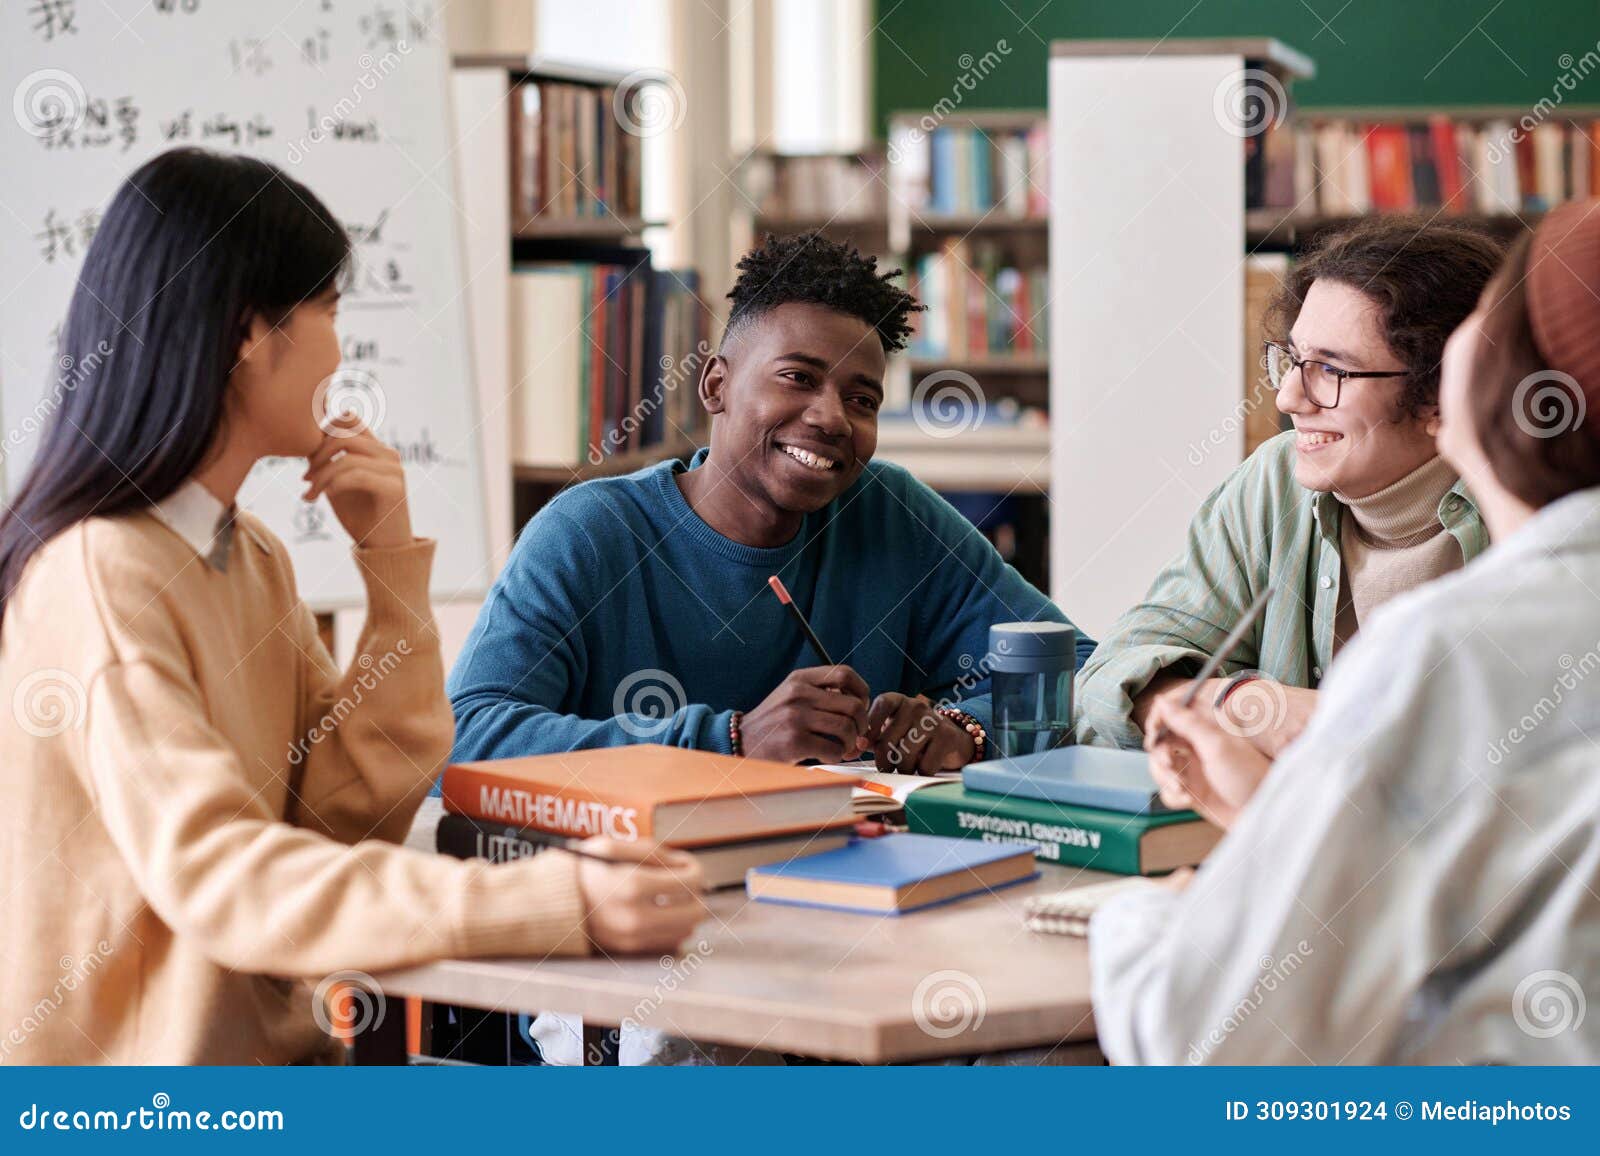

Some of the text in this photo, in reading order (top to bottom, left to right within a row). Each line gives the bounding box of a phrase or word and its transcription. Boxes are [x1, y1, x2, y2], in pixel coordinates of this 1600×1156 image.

[480, 785, 639, 843] MATHEMATICS
[957, 811, 1030, 836] LANGUAGE
[1031, 821, 1088, 847] SECOND
